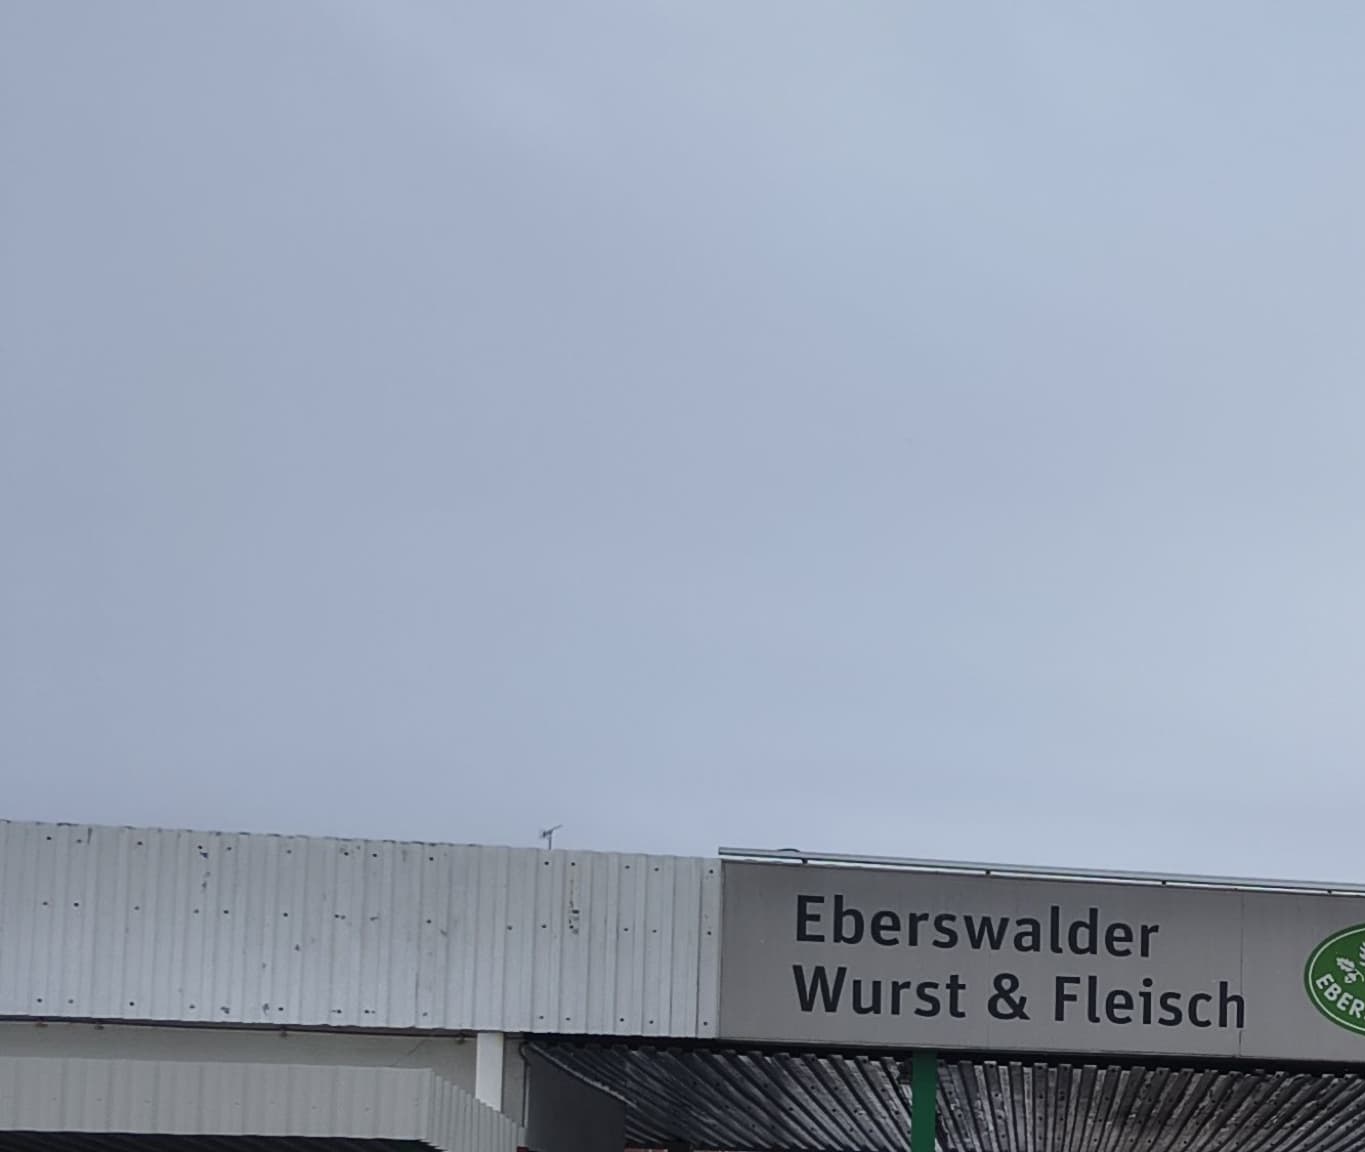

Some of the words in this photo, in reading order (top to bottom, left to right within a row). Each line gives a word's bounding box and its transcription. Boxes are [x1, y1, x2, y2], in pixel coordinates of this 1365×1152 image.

[796, 894, 1160, 957] Eberswalder
[792, 964, 966, 1019] Wurst
[987, 972, 1031, 1020] &
[1055, 975, 1245, 1029] Fleisch
